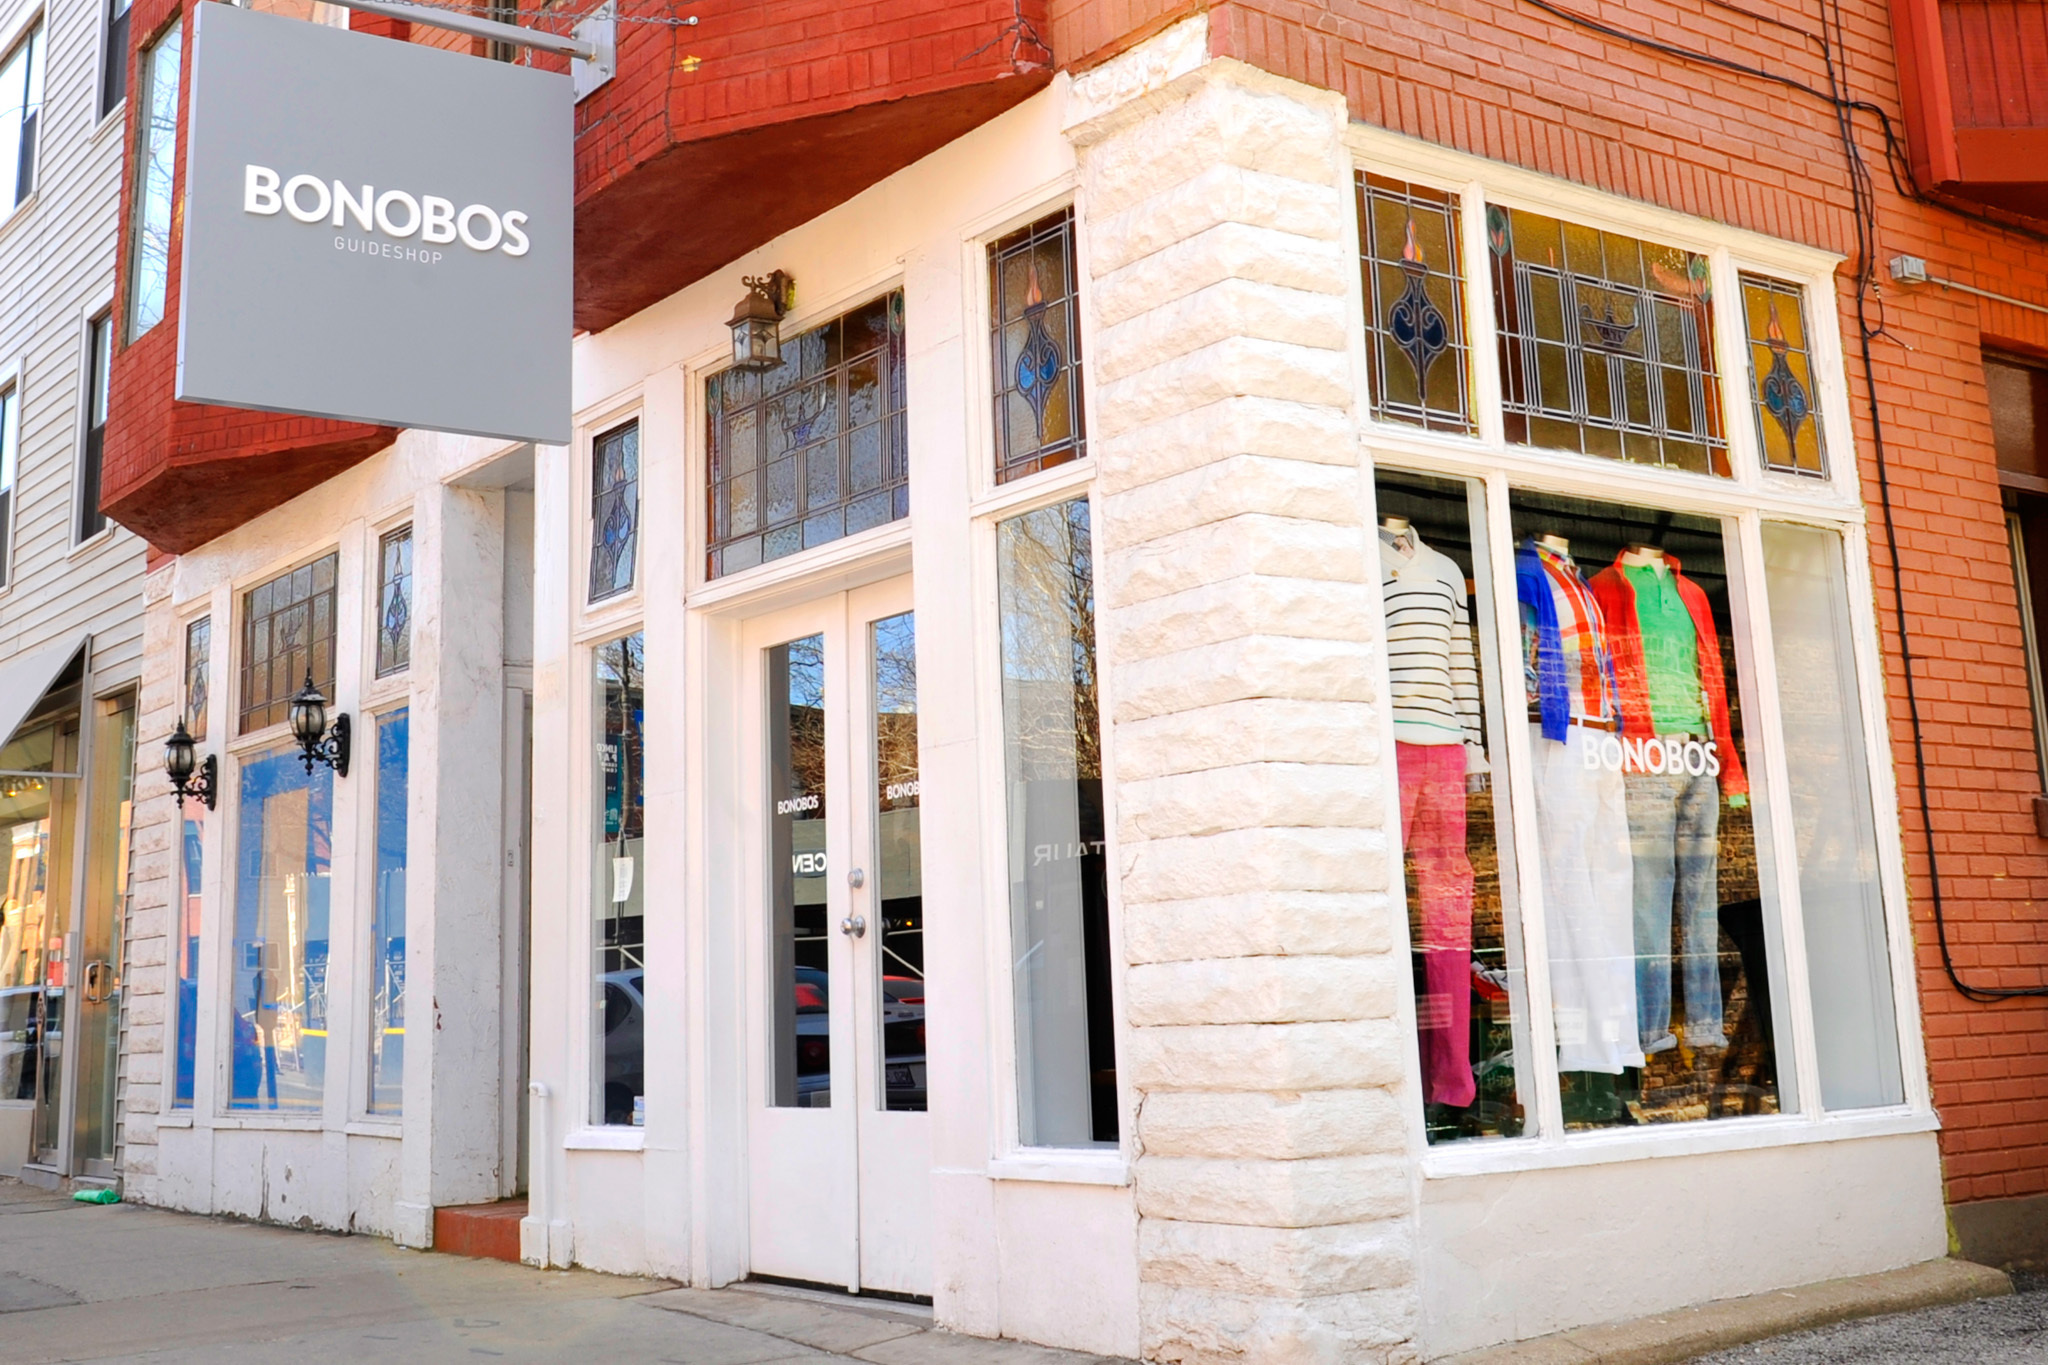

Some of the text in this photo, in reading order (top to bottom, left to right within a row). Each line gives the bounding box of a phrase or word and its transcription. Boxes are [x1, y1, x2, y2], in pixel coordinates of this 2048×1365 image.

[244, 164, 530, 257] BONOBOS
[334, 236, 443, 265] GUIDESHOP
[1581, 734, 1720, 777] BONOBOS
[777, 795, 819, 815] BONOBOS
